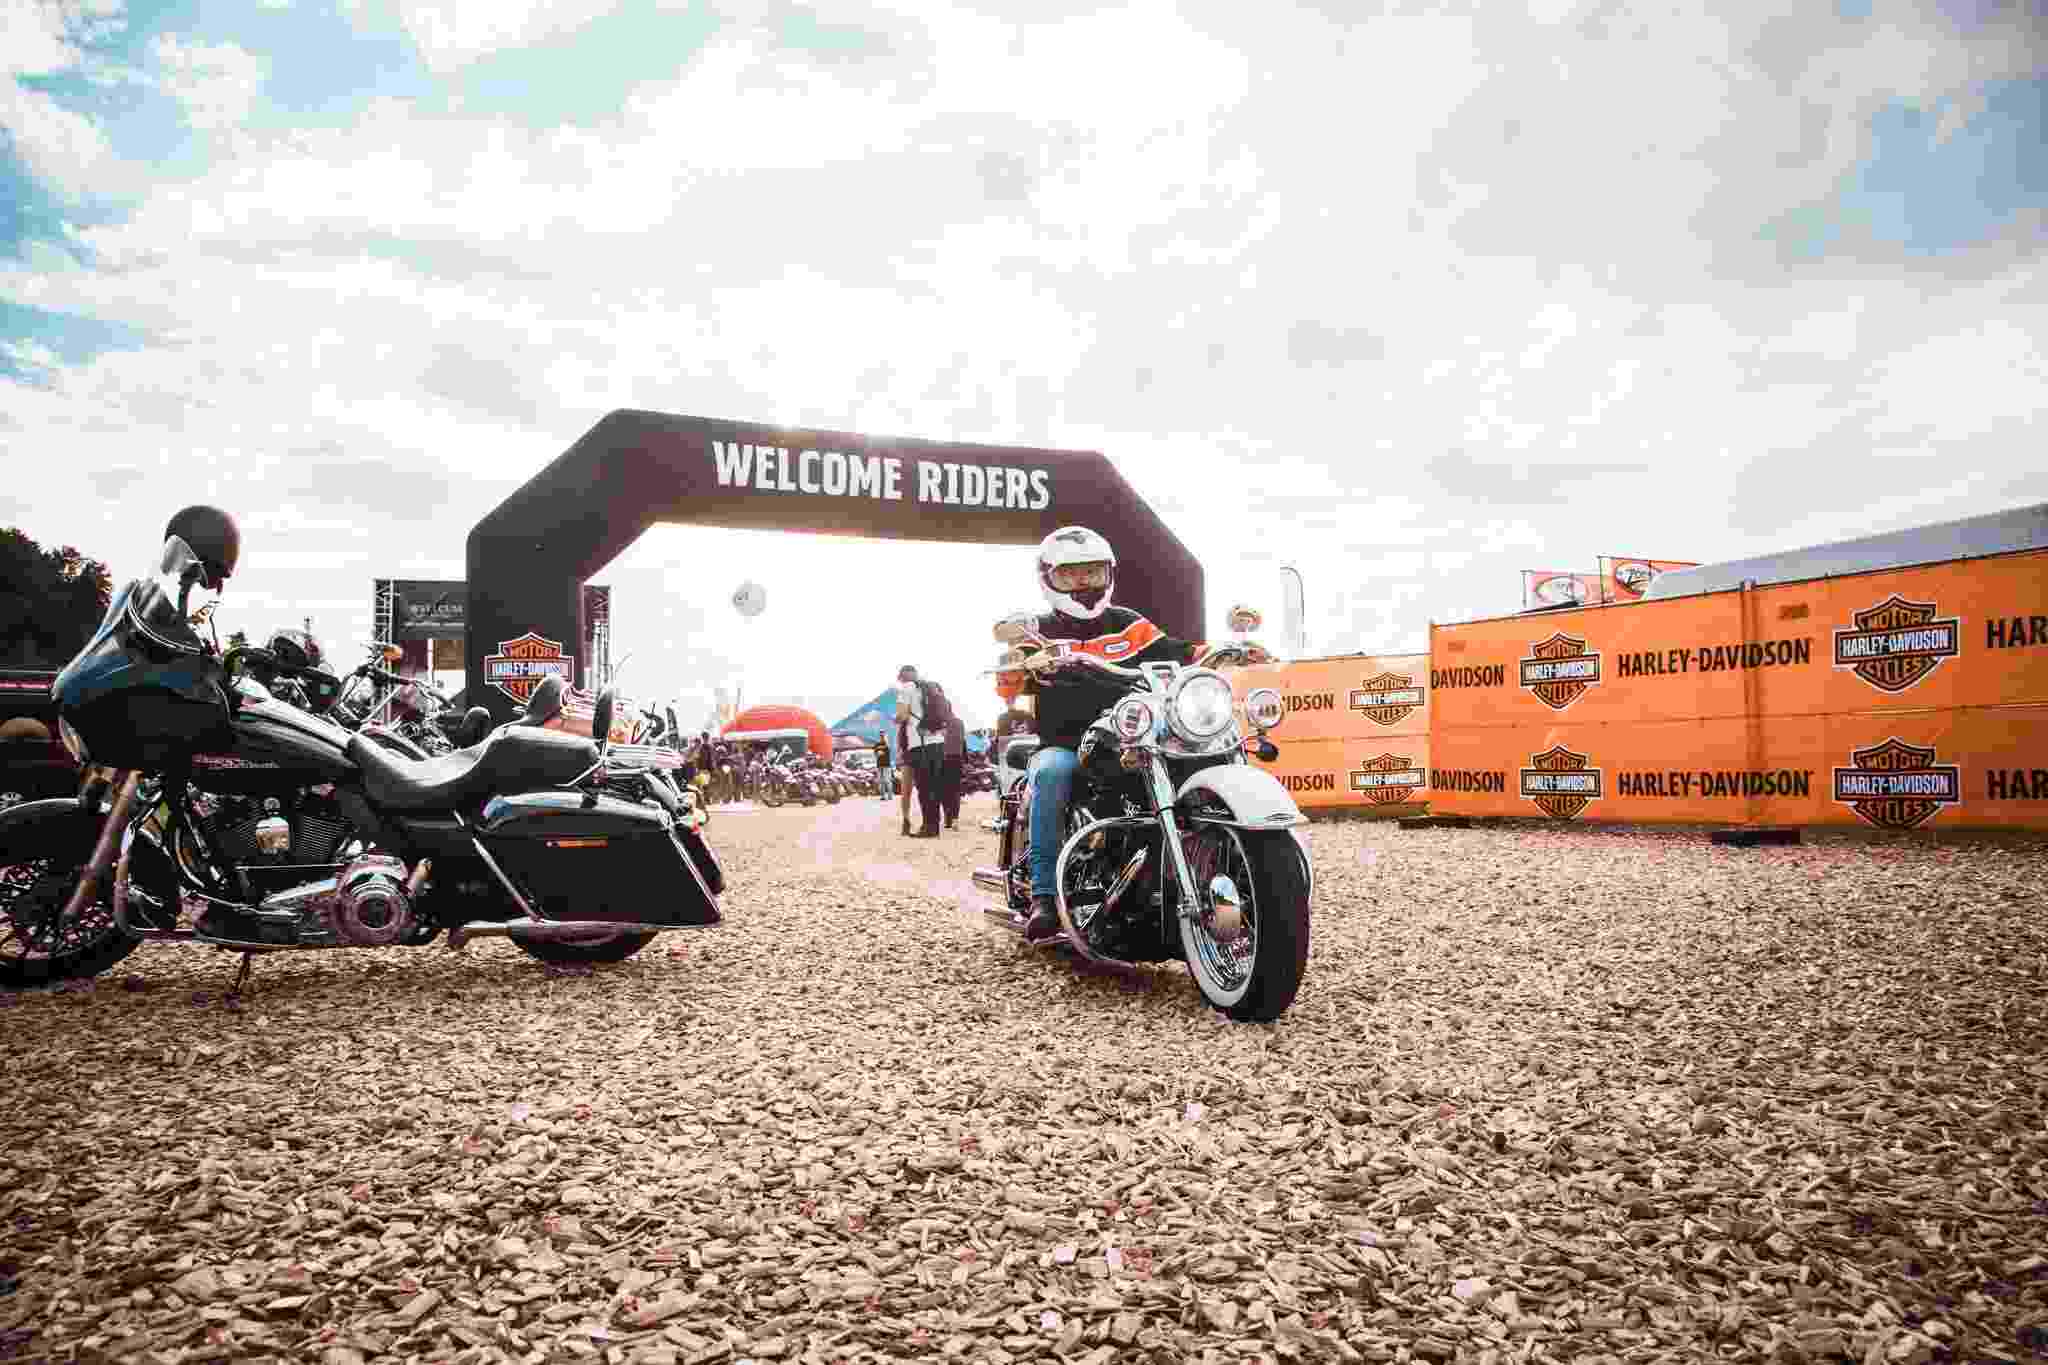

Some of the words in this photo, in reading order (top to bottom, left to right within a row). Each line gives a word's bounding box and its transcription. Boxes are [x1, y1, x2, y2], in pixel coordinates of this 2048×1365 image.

[712, 440, 902, 500] WELCOME
[917, 460, 1050, 510] RIDERS
[1842, 628, 1950, 657] HARLEY-DAVIDSON
[1617, 638, 1811, 678] HARLEY-DAVIDSON
[1431, 664, 1504, 689] DAVIDSON
[1281, 693, 1335, 712] IDSON
[1431, 768, 1504, 792] DAVIDSON
[1617, 770, 1811, 799] HARLEY-DAVIDSON
[1842, 774, 1950, 795] HARLEY-DAVIDSON
